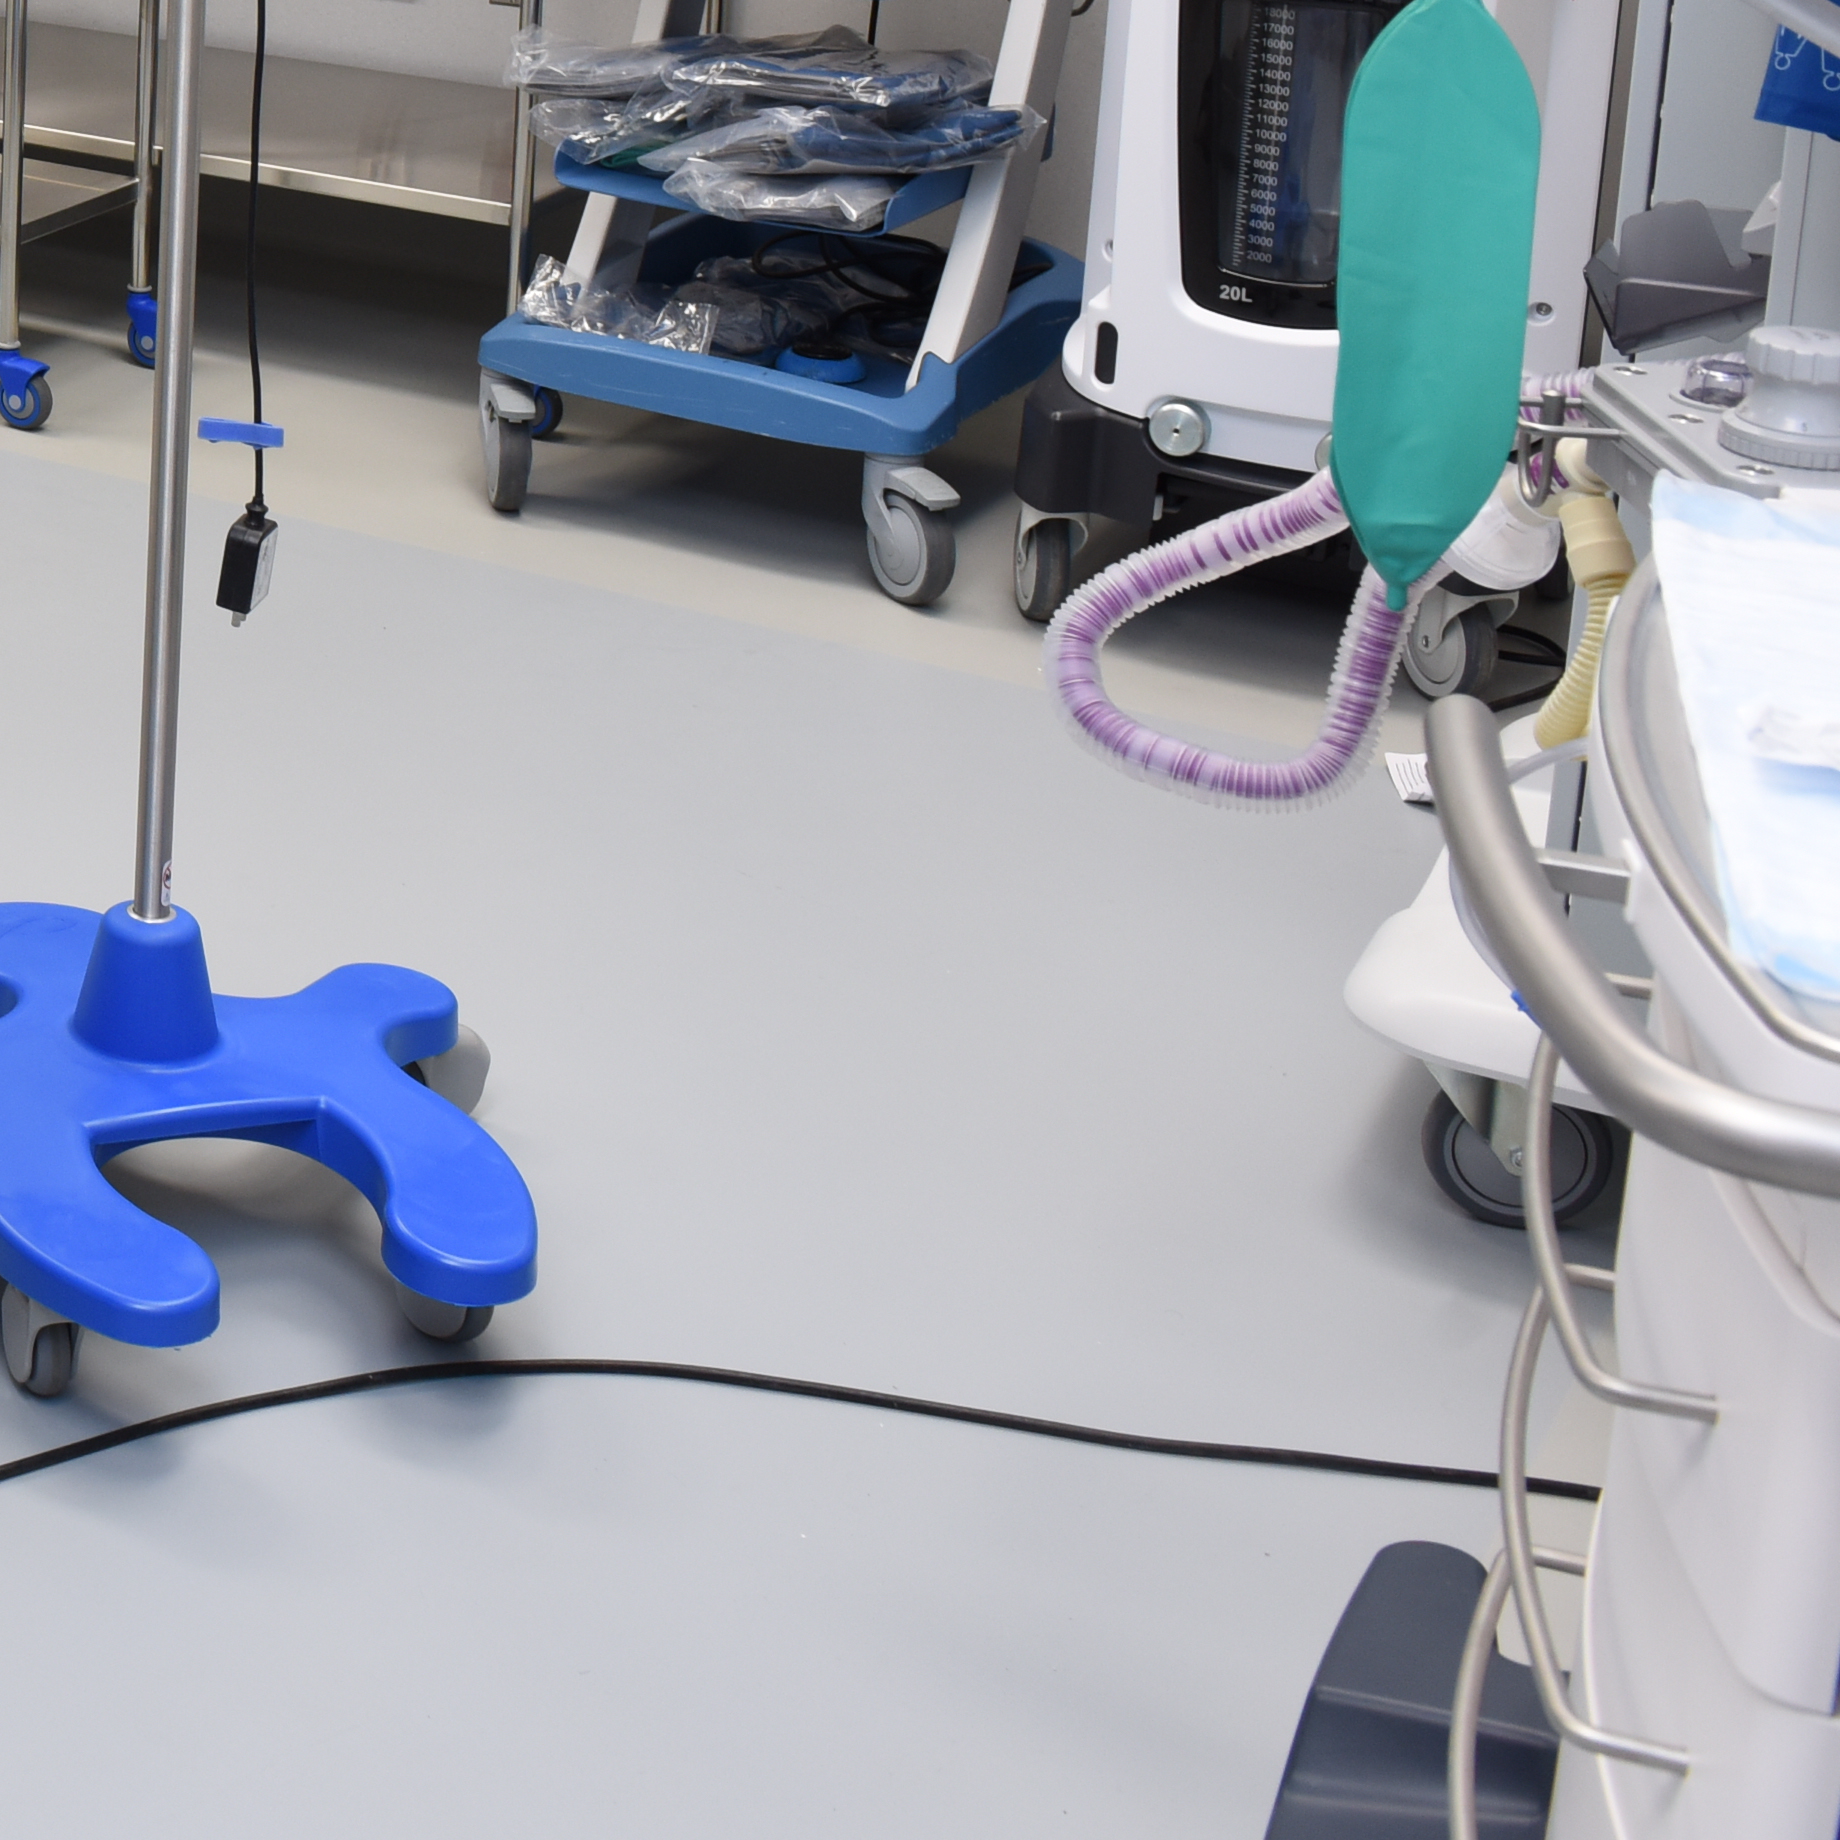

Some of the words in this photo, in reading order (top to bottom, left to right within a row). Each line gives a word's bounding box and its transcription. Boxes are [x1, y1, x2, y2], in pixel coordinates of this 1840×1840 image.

[1263, 22, 1295, 36] 17000
[1262, 37, 1293, 51] 16000
[1260, 52, 1292, 66] 15000
[1259, 67, 1291, 81] 14000
[1258, 83, 1290, 97] 13000
[1257, 98, 1289, 111] 12000
[1256, 113, 1288, 127] 11000
[1255, 128, 1287, 142] 10000
[1254, 143, 1280, 157] 9000
[1253, 158, 1279, 172] 8000
[1252, 173, 1278, 187] 7000
[1251, 189, 1277, 202] 6000
[1249, 204, 1275, 216] 5000
[1248, 219, 1275, 232] 4000
[1247, 234, 1273, 247] 3000
[1246, 250, 1272, 263] 2000
[1219, 284, 1253, 302] 20L
